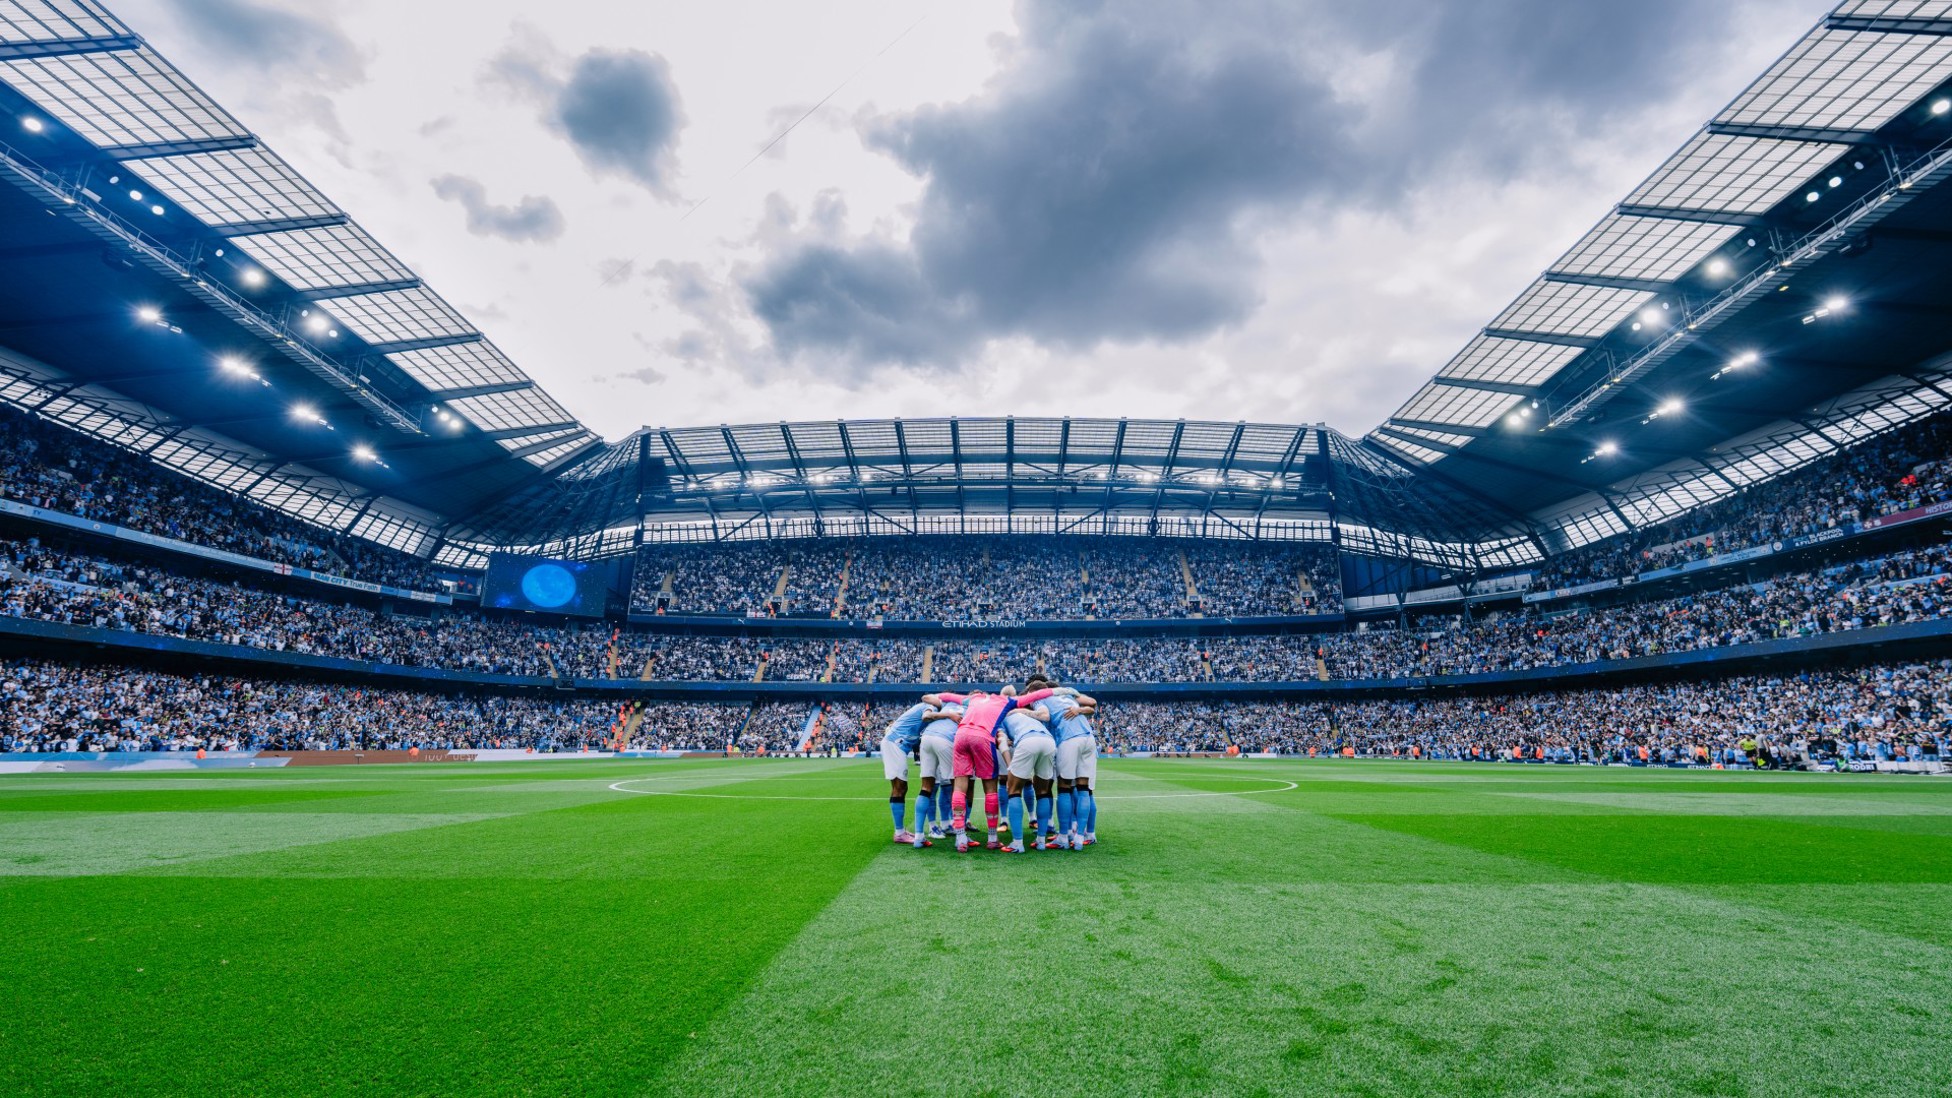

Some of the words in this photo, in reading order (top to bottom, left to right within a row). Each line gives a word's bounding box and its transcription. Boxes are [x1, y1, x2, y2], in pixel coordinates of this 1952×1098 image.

[331, 577, 347, 586] CITY
[942, 620, 988, 628] ETIHAD
[990, 620, 1026, 628] STADIUM
